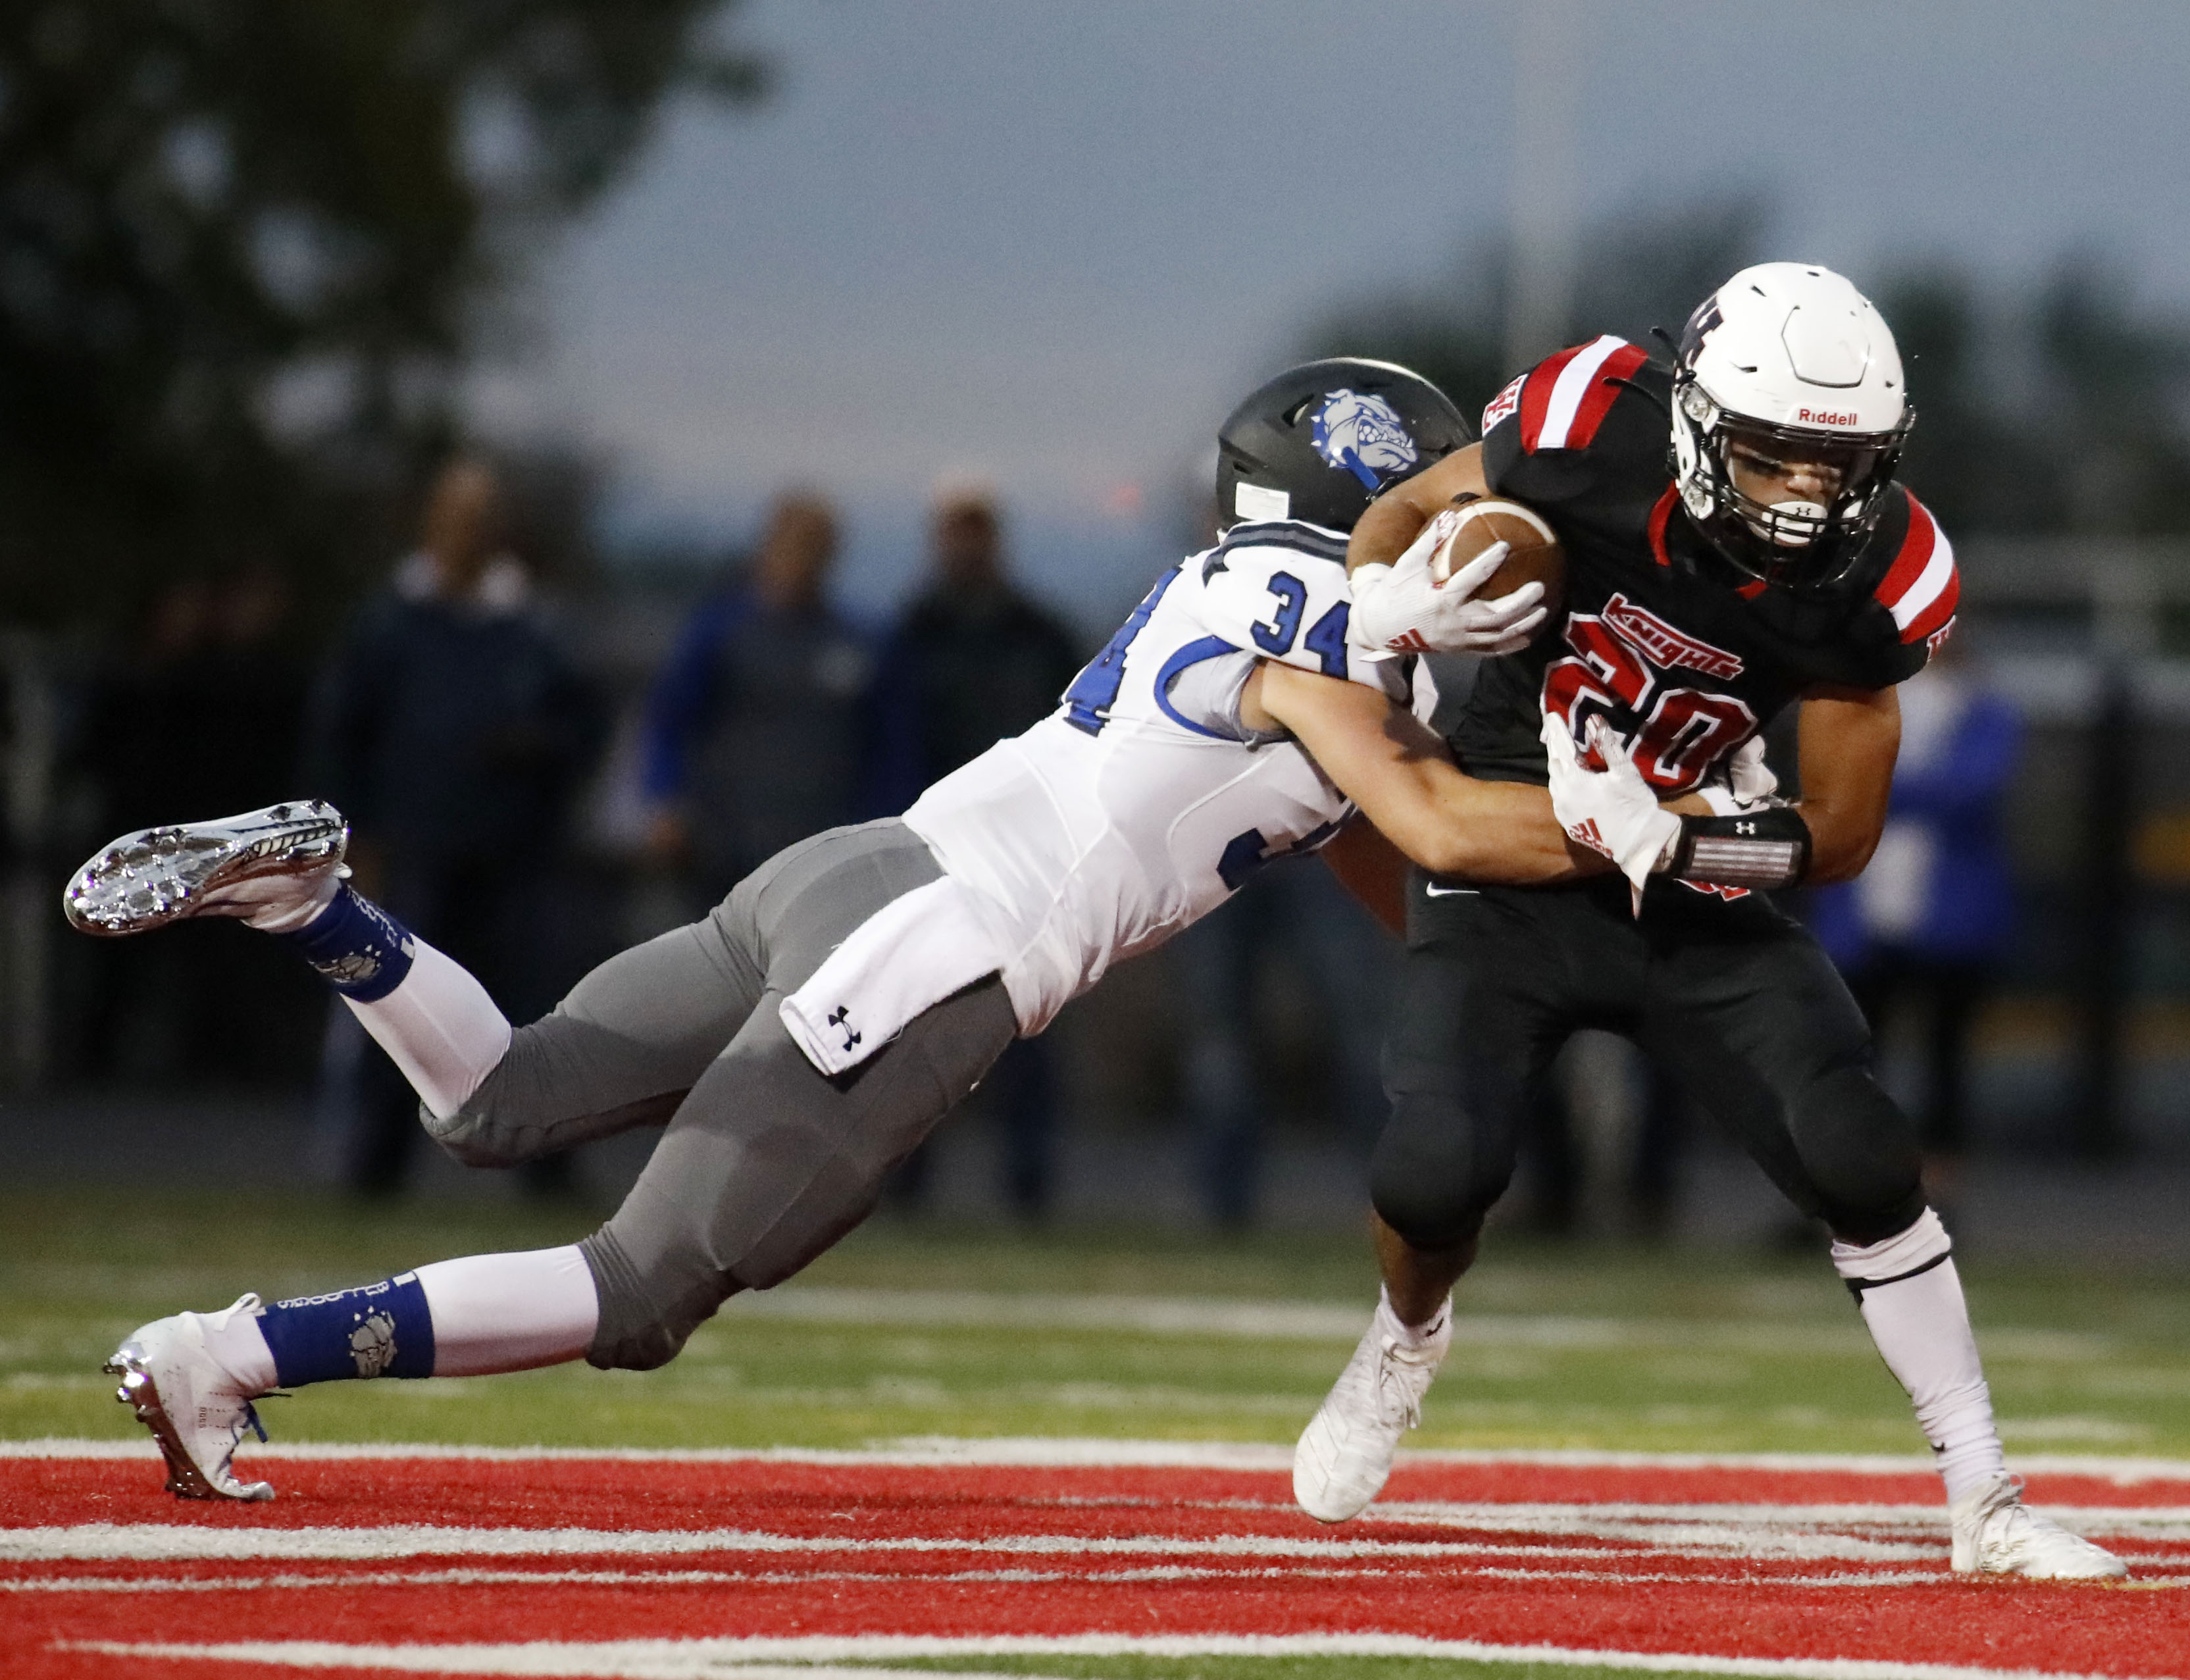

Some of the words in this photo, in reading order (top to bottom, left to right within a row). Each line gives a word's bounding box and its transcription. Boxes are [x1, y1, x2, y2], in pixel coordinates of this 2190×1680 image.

[1798, 408, 1857, 426] Riddell
[1250, 570, 1351, 680] 34
[1540, 611, 1759, 790] 20
